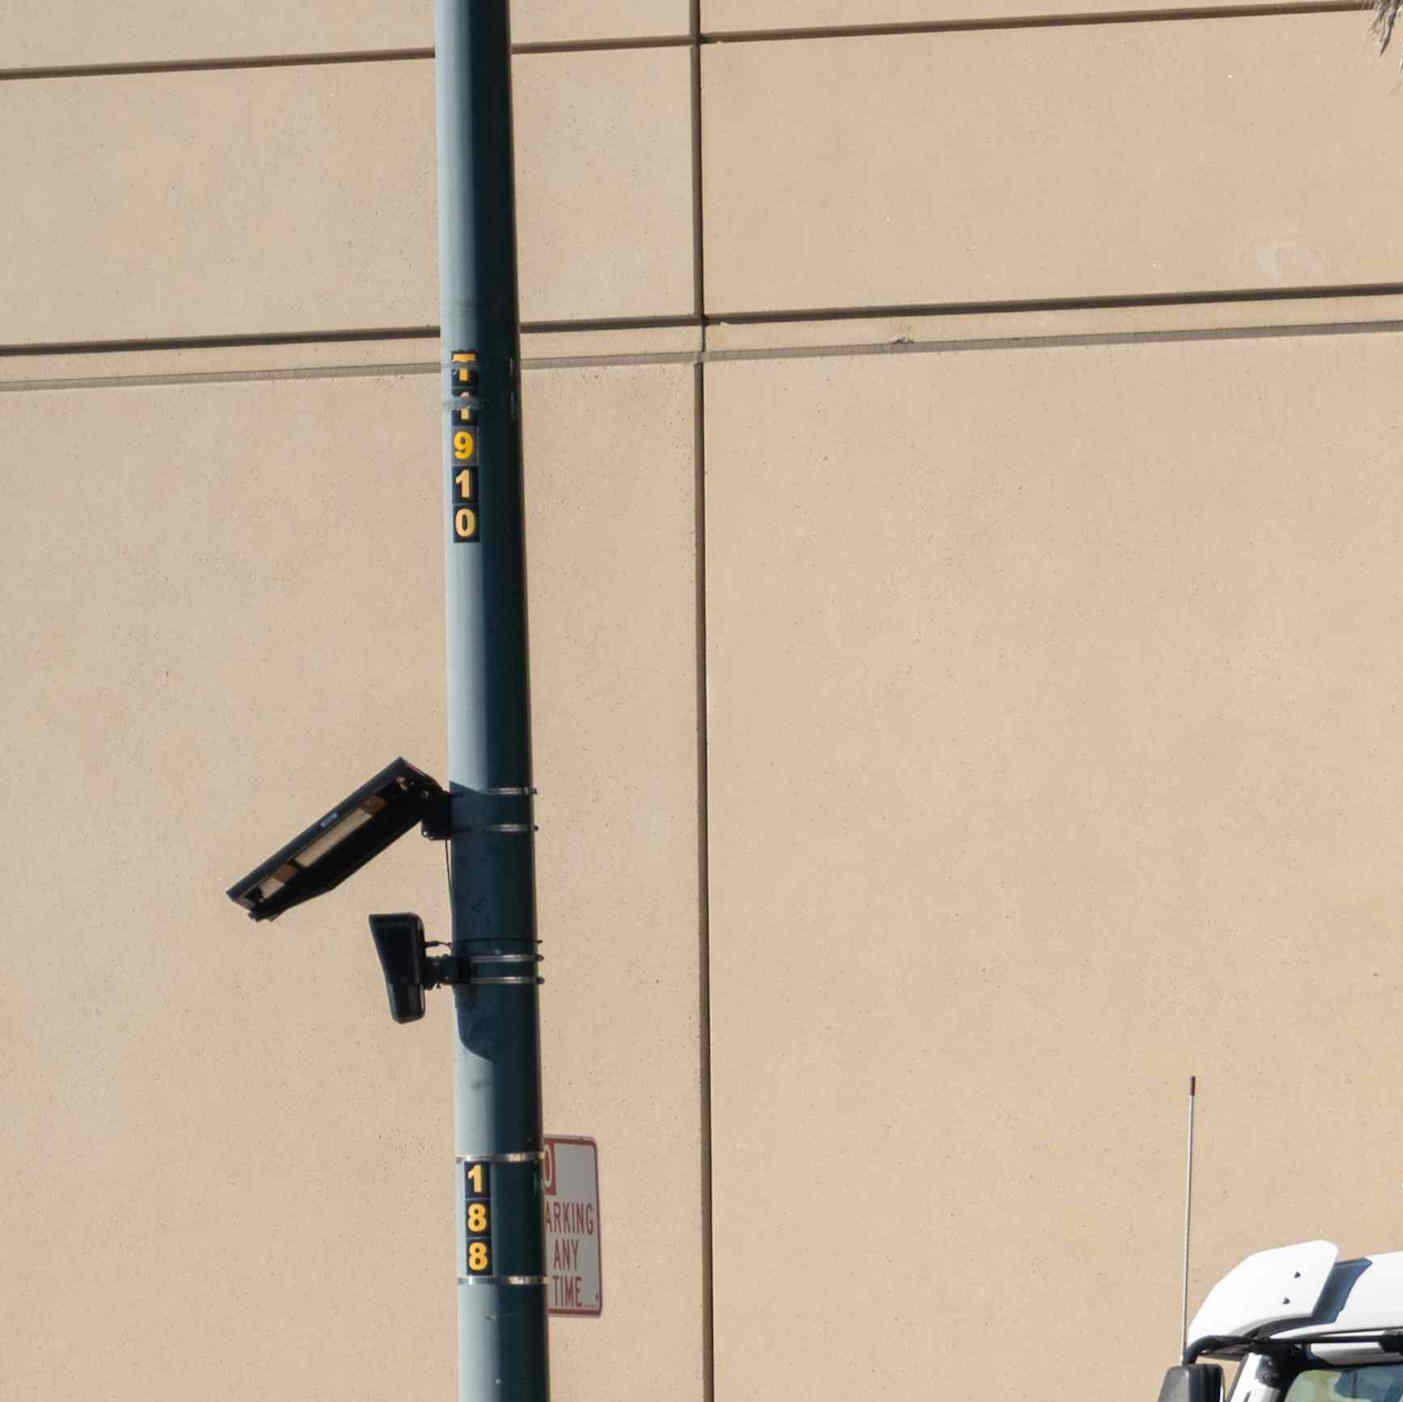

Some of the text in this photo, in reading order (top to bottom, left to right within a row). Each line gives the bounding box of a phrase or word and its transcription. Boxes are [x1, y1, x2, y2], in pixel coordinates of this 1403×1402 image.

[467, 1164, 488, 1271] 188
[544, 1201, 593, 1235] ARKING
[553, 1239, 578, 1271] ANY
[552, 1275, 582, 1307] TIME
